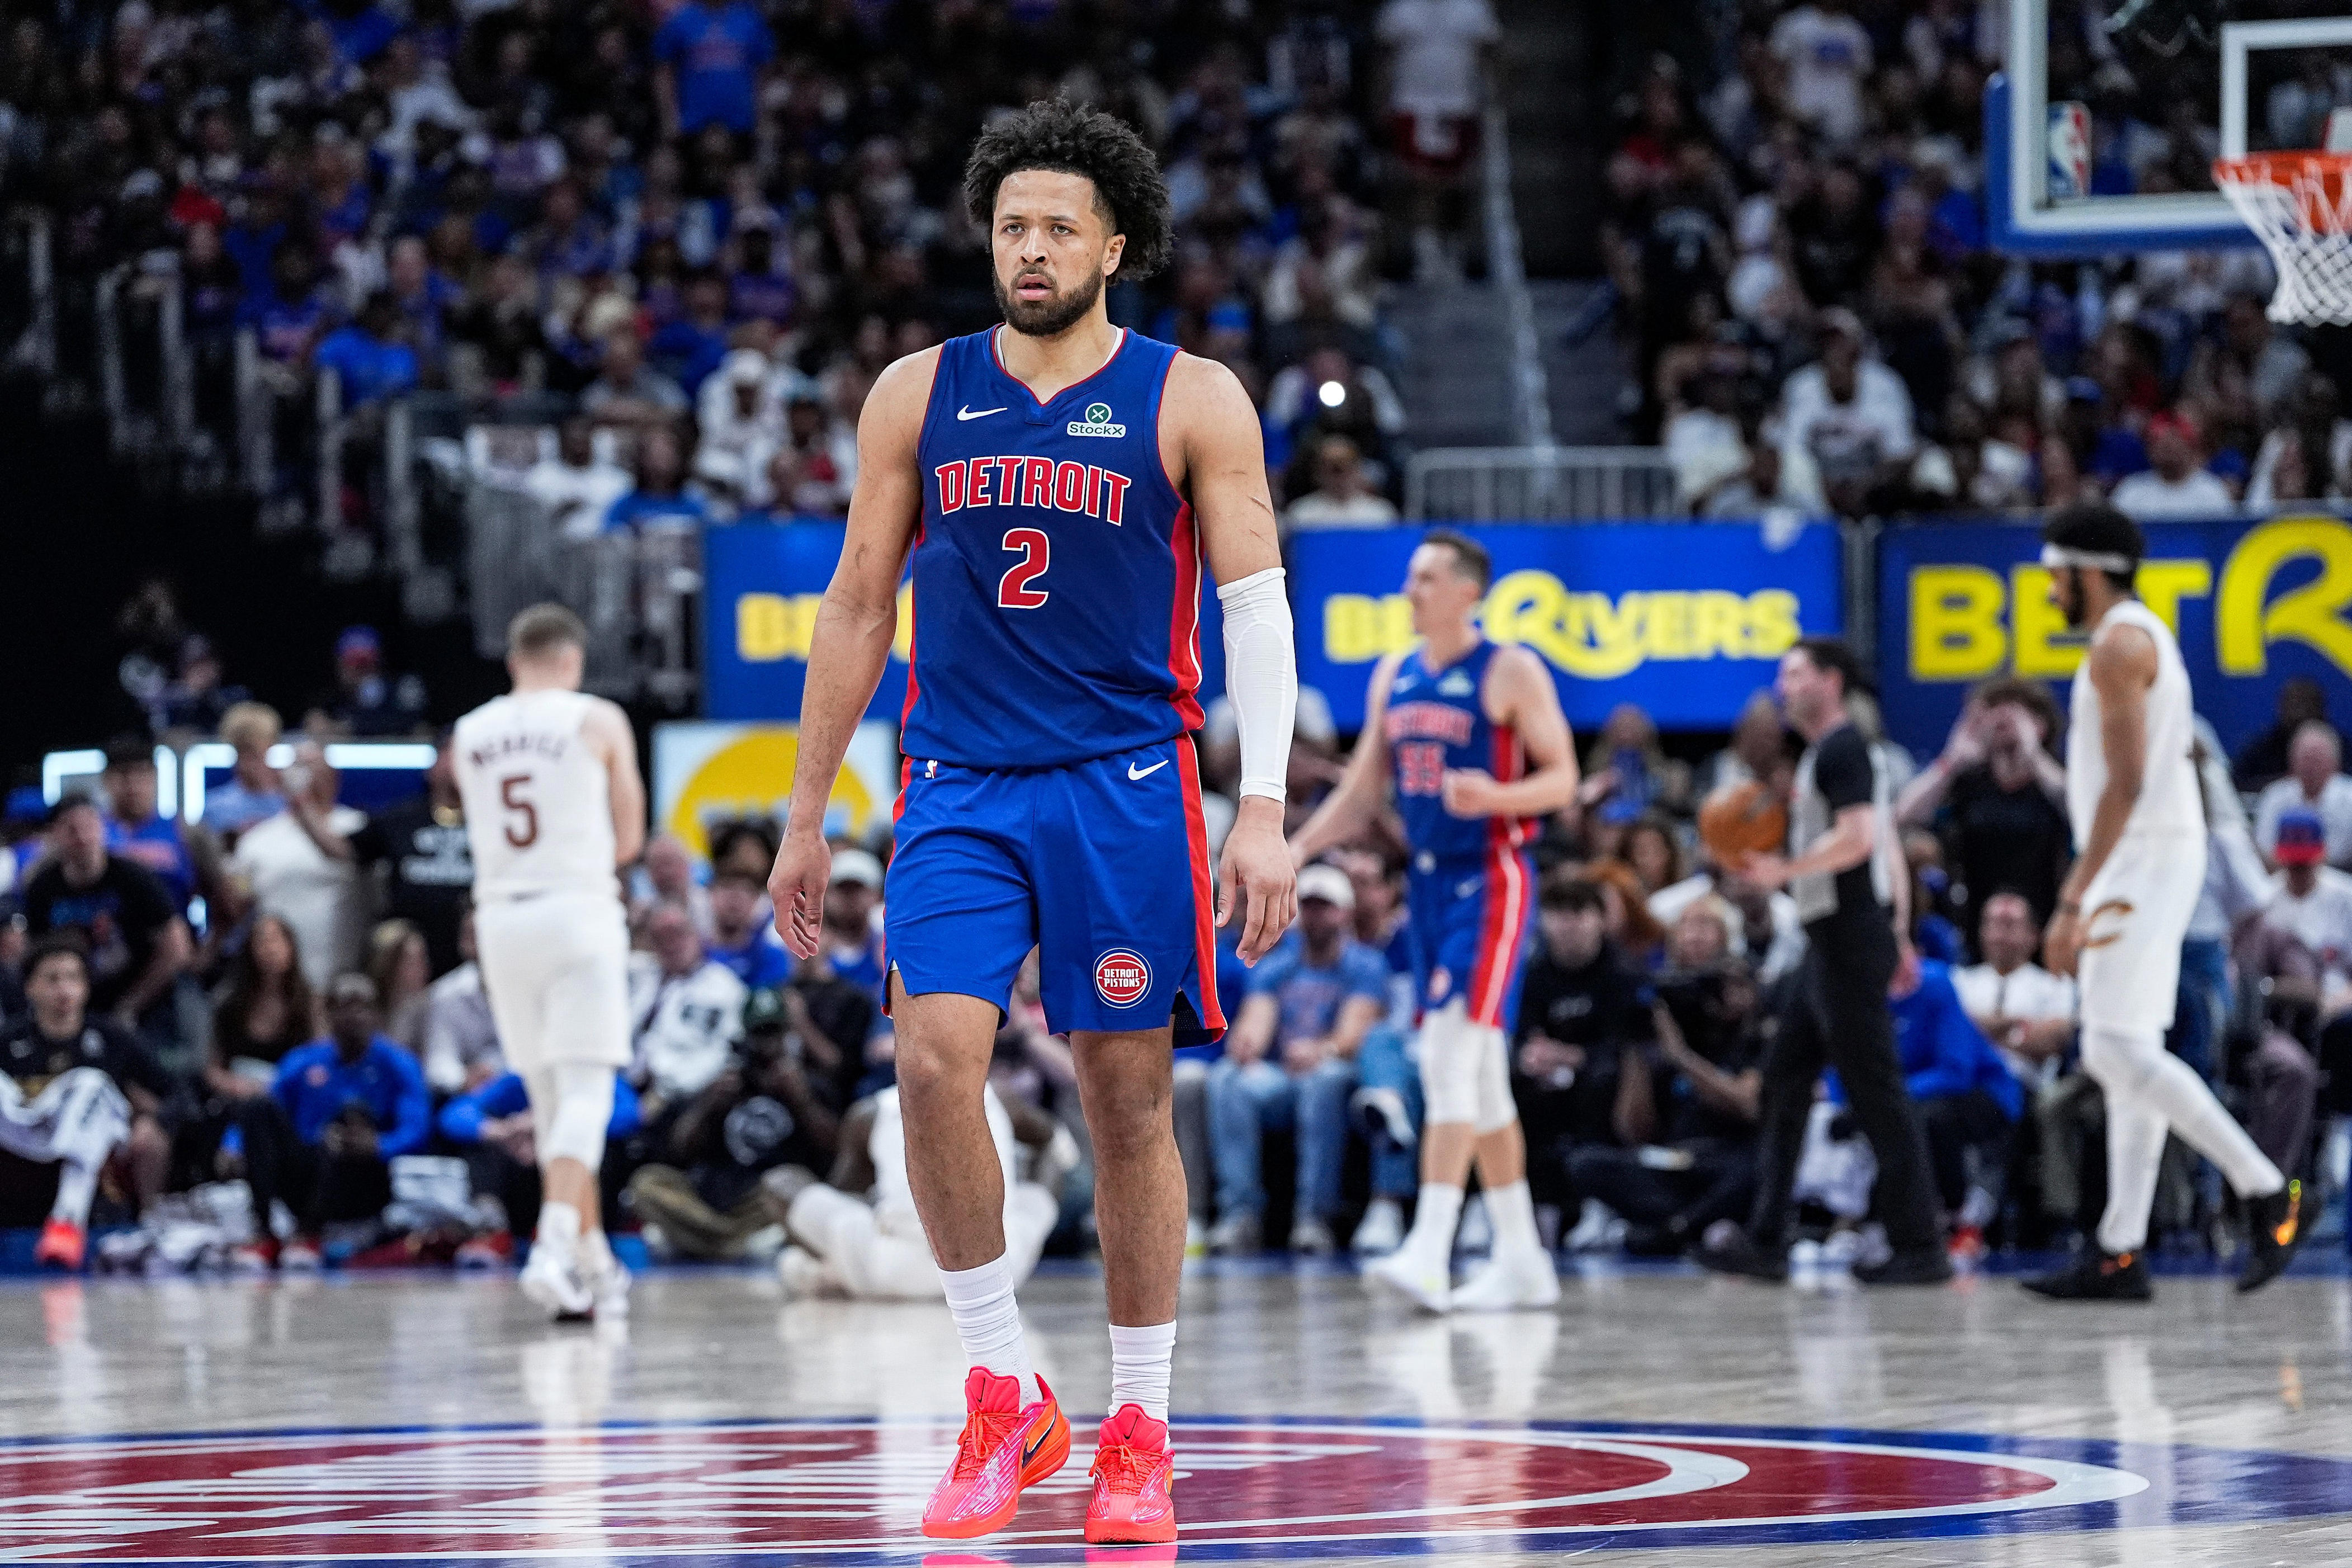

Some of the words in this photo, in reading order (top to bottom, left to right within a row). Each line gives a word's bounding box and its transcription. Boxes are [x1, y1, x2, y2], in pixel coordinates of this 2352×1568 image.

[1069, 423, 1123, 436] StockX
[935, 455, 1132, 527] DETROIT
[998, 527, 1050, 610] 2
[500, 773, 539, 848] 5
[1103, 969, 1140, 978] DETROIT
[1103, 978, 1140, 988] PISTONS
